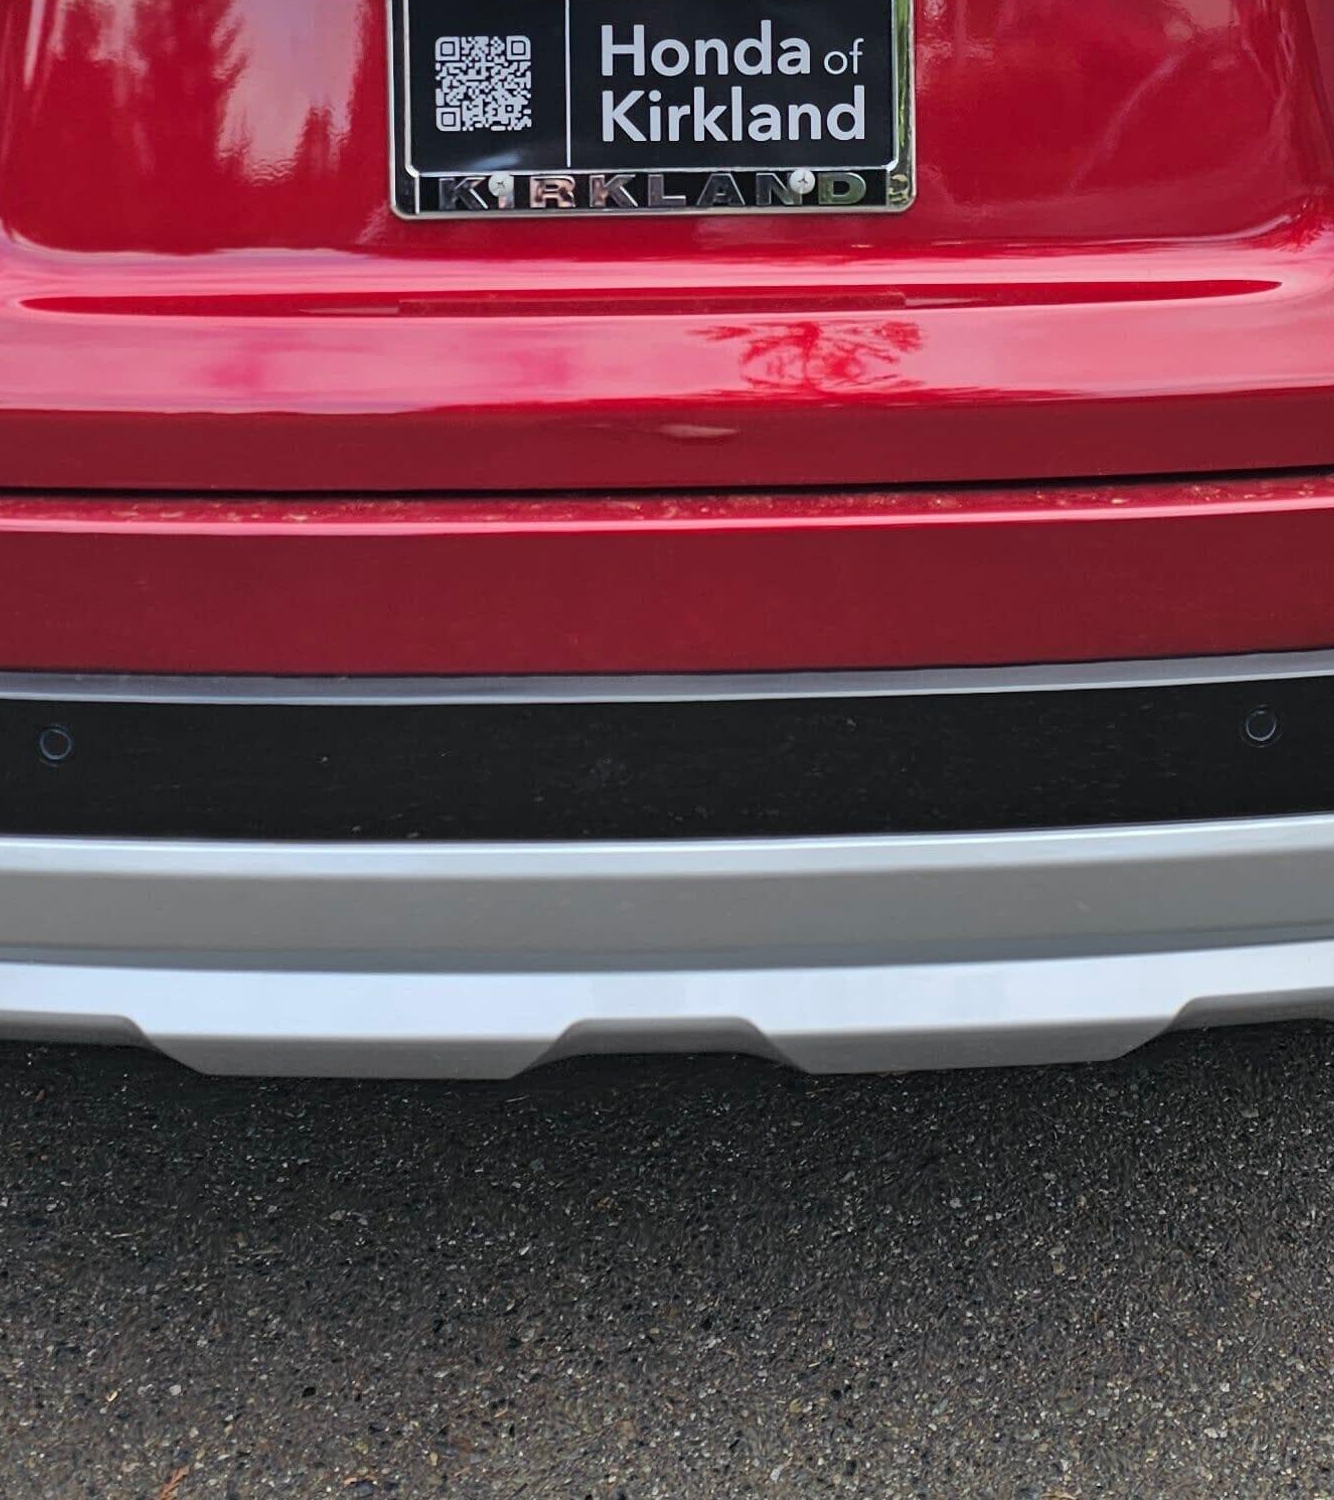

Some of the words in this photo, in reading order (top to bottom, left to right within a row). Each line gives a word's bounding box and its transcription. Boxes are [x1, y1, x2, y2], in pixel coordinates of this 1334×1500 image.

[601, 21, 810, 76] Honda
[823, 38, 863, 75] of
[601, 84, 865, 142] Kirkland
